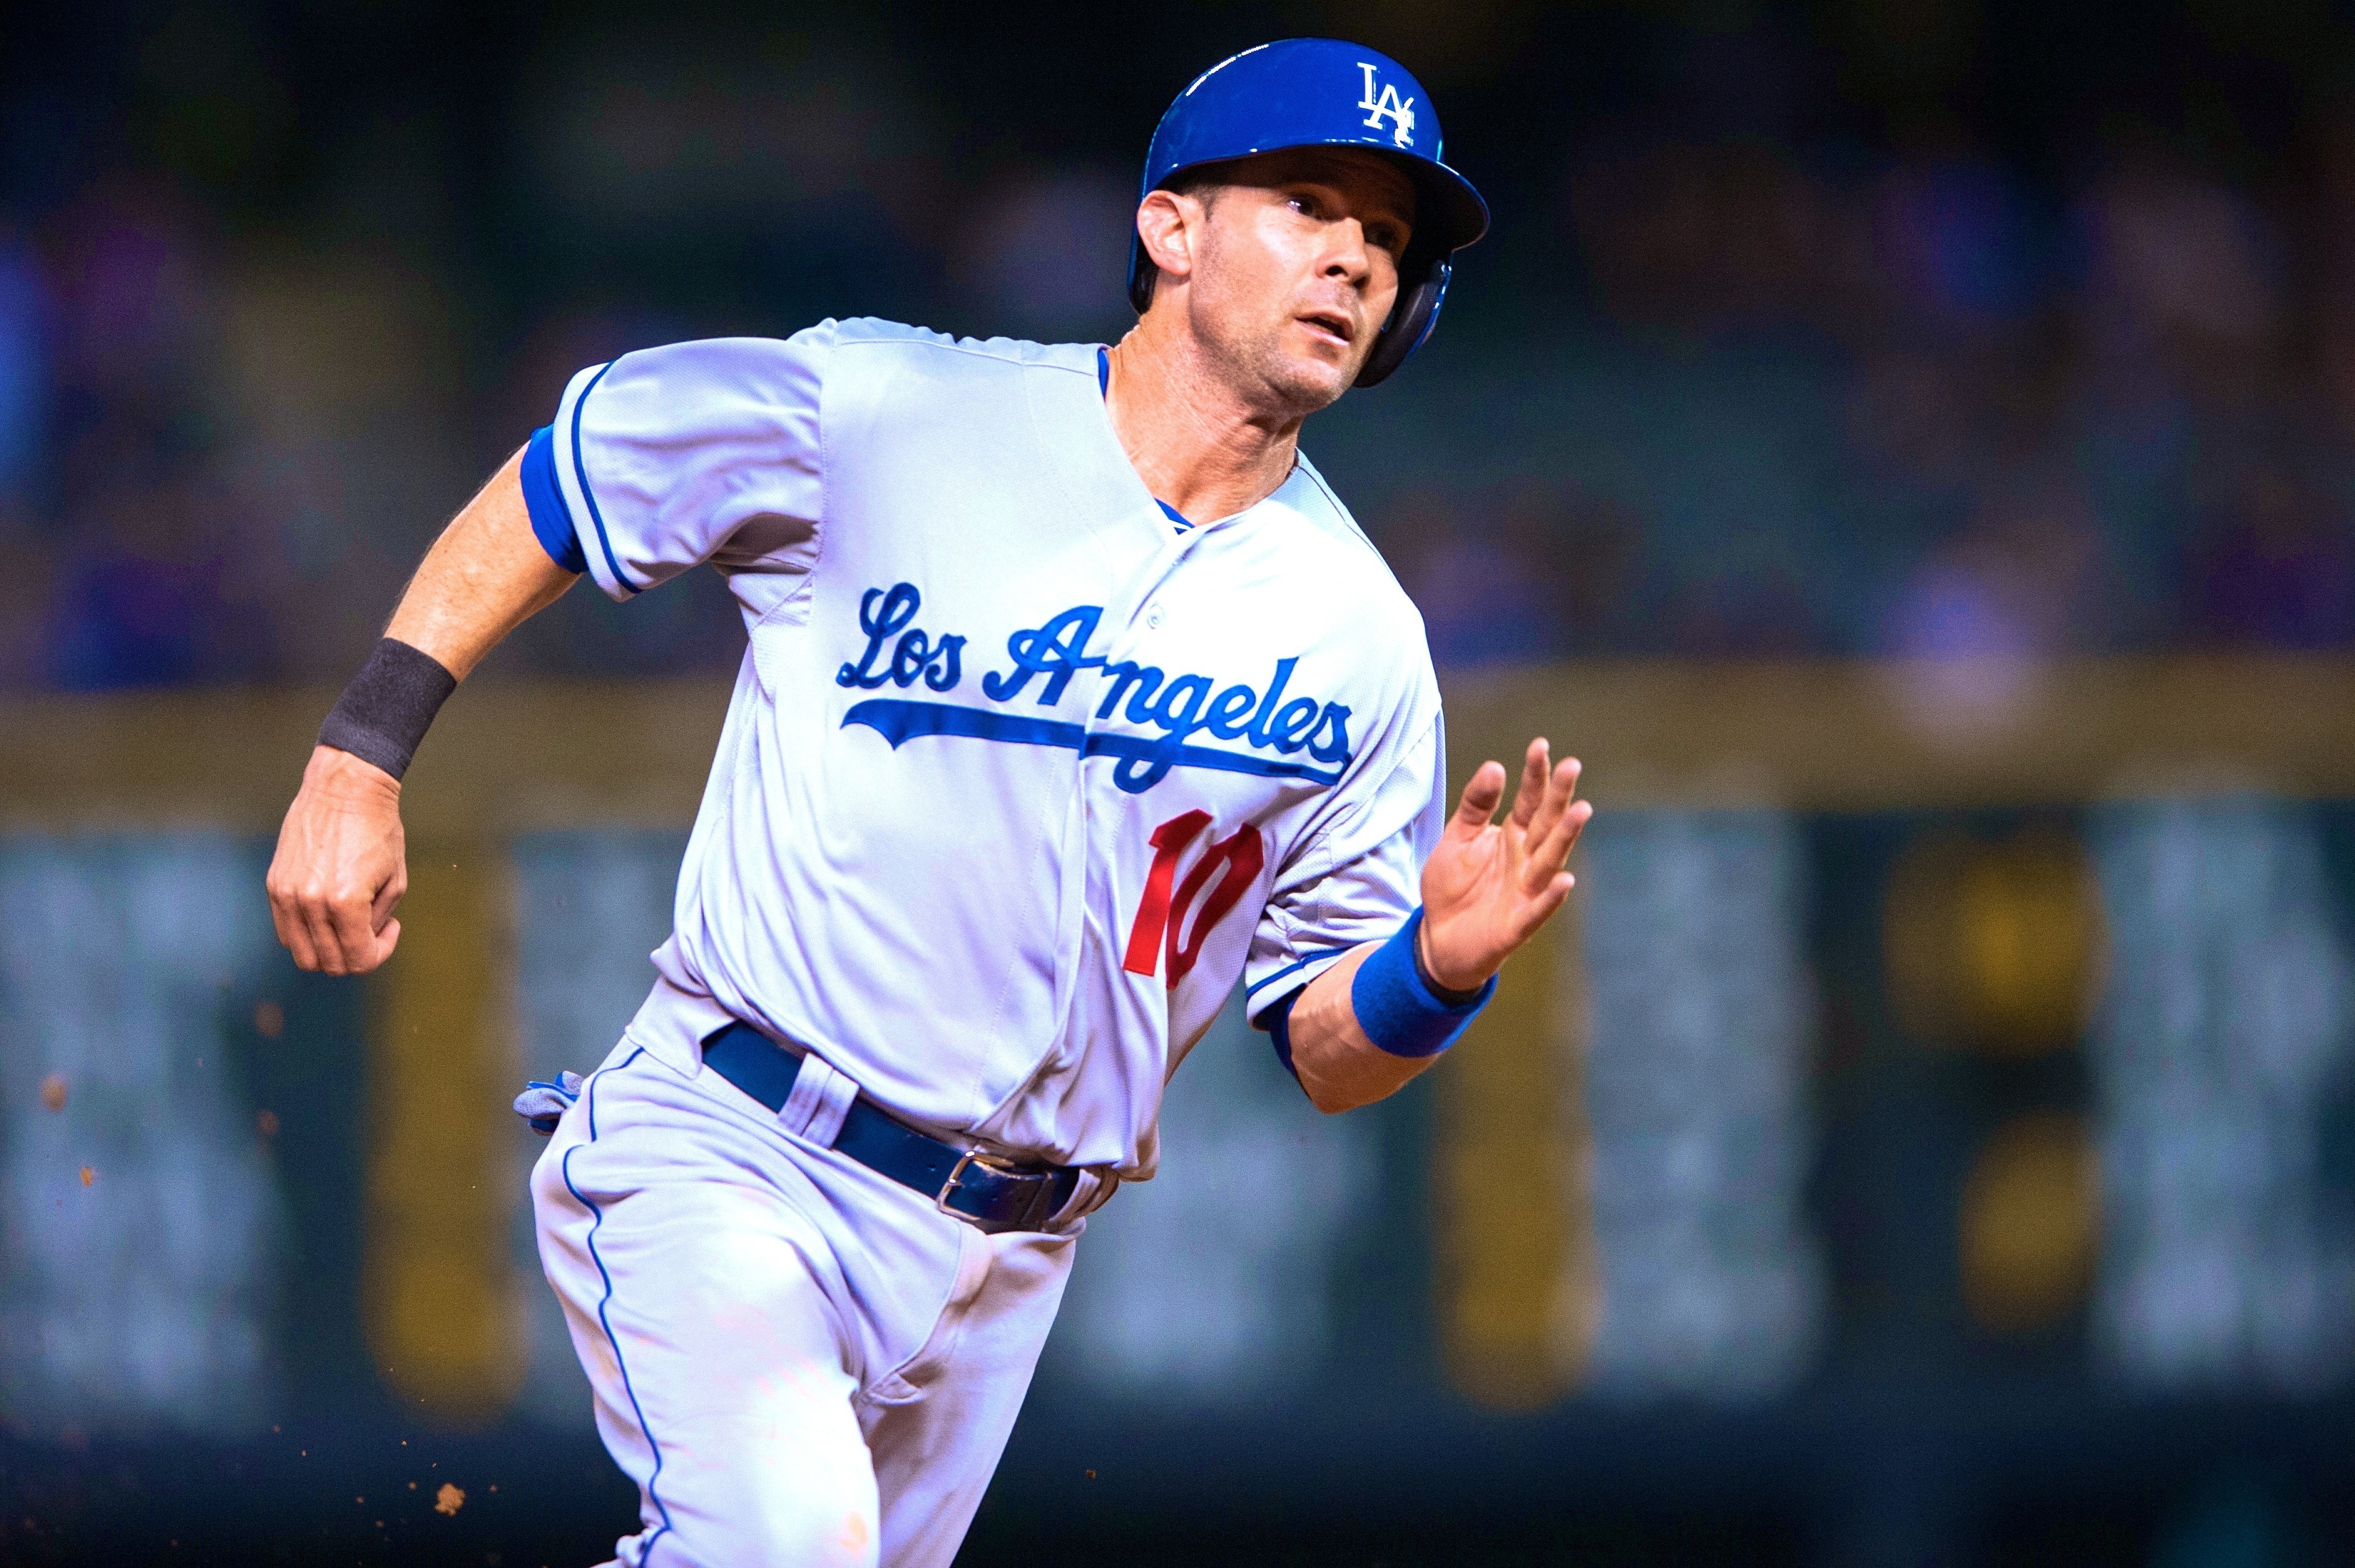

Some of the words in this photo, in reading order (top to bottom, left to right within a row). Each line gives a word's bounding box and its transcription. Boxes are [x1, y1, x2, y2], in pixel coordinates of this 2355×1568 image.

[1357, 62, 1415, 149] LA
[836, 582, 968, 691] Los
[982, 605, 1353, 794] Angeles
[1122, 808, 1264, 990] 10
